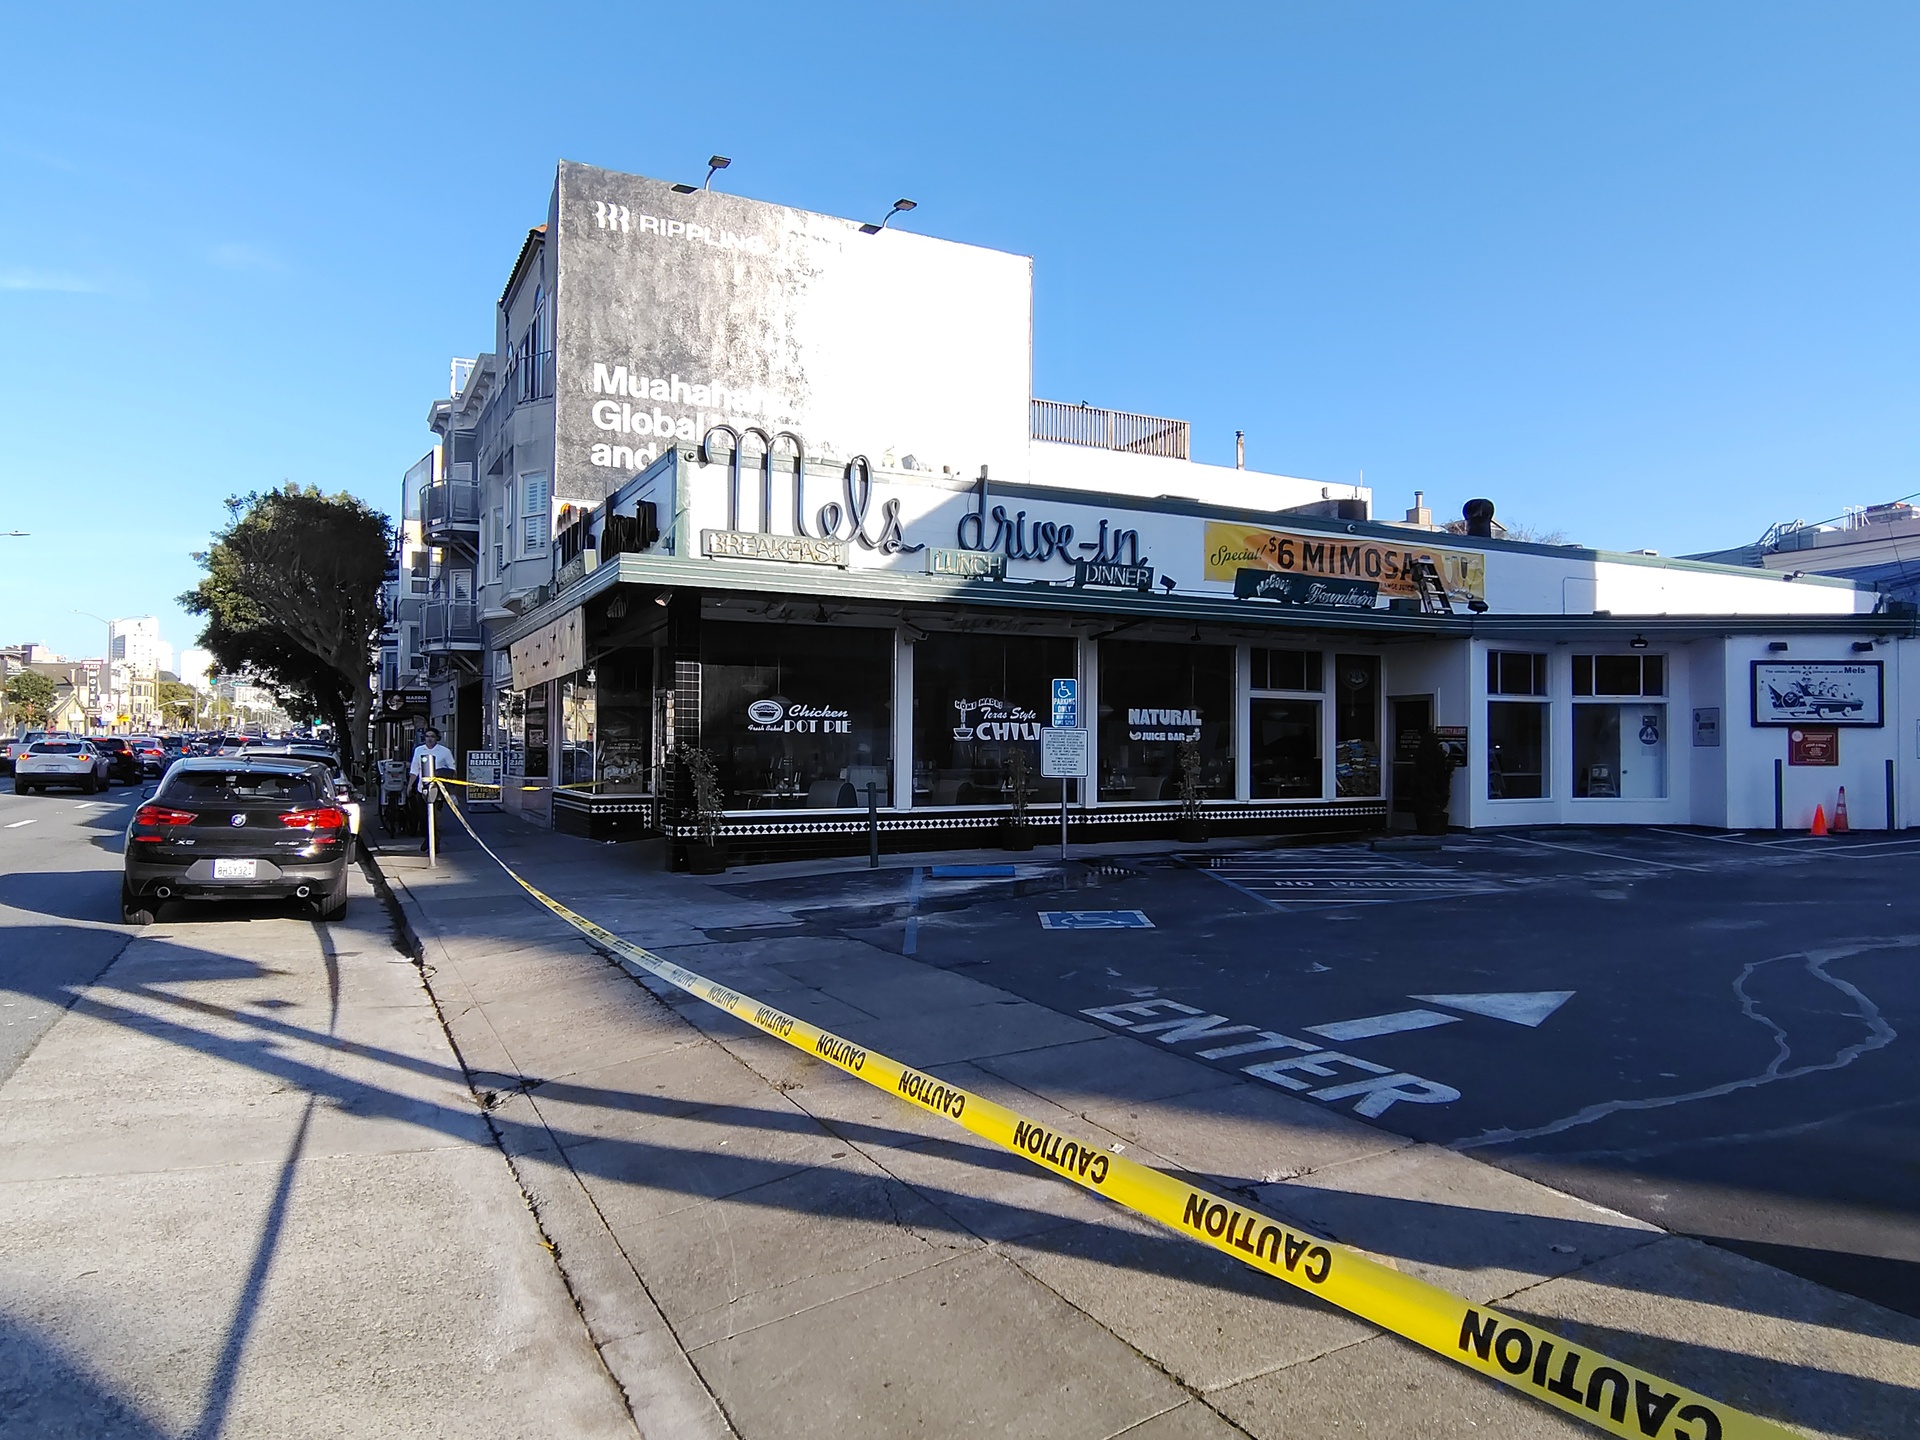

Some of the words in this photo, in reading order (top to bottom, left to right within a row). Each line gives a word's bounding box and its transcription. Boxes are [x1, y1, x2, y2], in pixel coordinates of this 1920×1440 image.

[639, 213, 770, 255] RIPPLING
[591, 399, 704, 440] Global
[590, 442, 657, 471] and
[703, 424, 925, 555] Mels
[708, 532, 843, 563] BREAKFAST
[1210, 544, 1267, 566] Special!
[934, 551, 1002, 575] LUNCH
[1085, 564, 1149, 586] DINNER
[1844, 666, 1866, 674] Mels
[89, 671, 97, 708] MOTEL
[788, 704, 849, 718] Chicken
[981, 706, 1008, 719] Texas
[1010, 706, 1037, 721] Style
[1128, 708, 1203, 726] NATURAL
[784, 719, 818, 733] POT
[824, 719, 852, 733] PIE
[976, 721, 1041, 741] CHILI
[1142, 731, 1166, 741] JUICE
[1167, 732, 1185, 741] BAR
[1274, 880, 1314, 888] NO
[706, 985, 740, 1010] CAUTION
[753, 1007, 795, 1037] CAUTION
[816, 1034, 866, 1072] CAUTION
[1080, 998, 1462, 1118] ENTER
[898, 1070, 966, 1119] CAUTION
[1011, 1120, 1110, 1185] CAUTION
[1183, 1193, 1333, 1285] CAUTION
[1458, 1309, 1724, 1440] CAUTION
